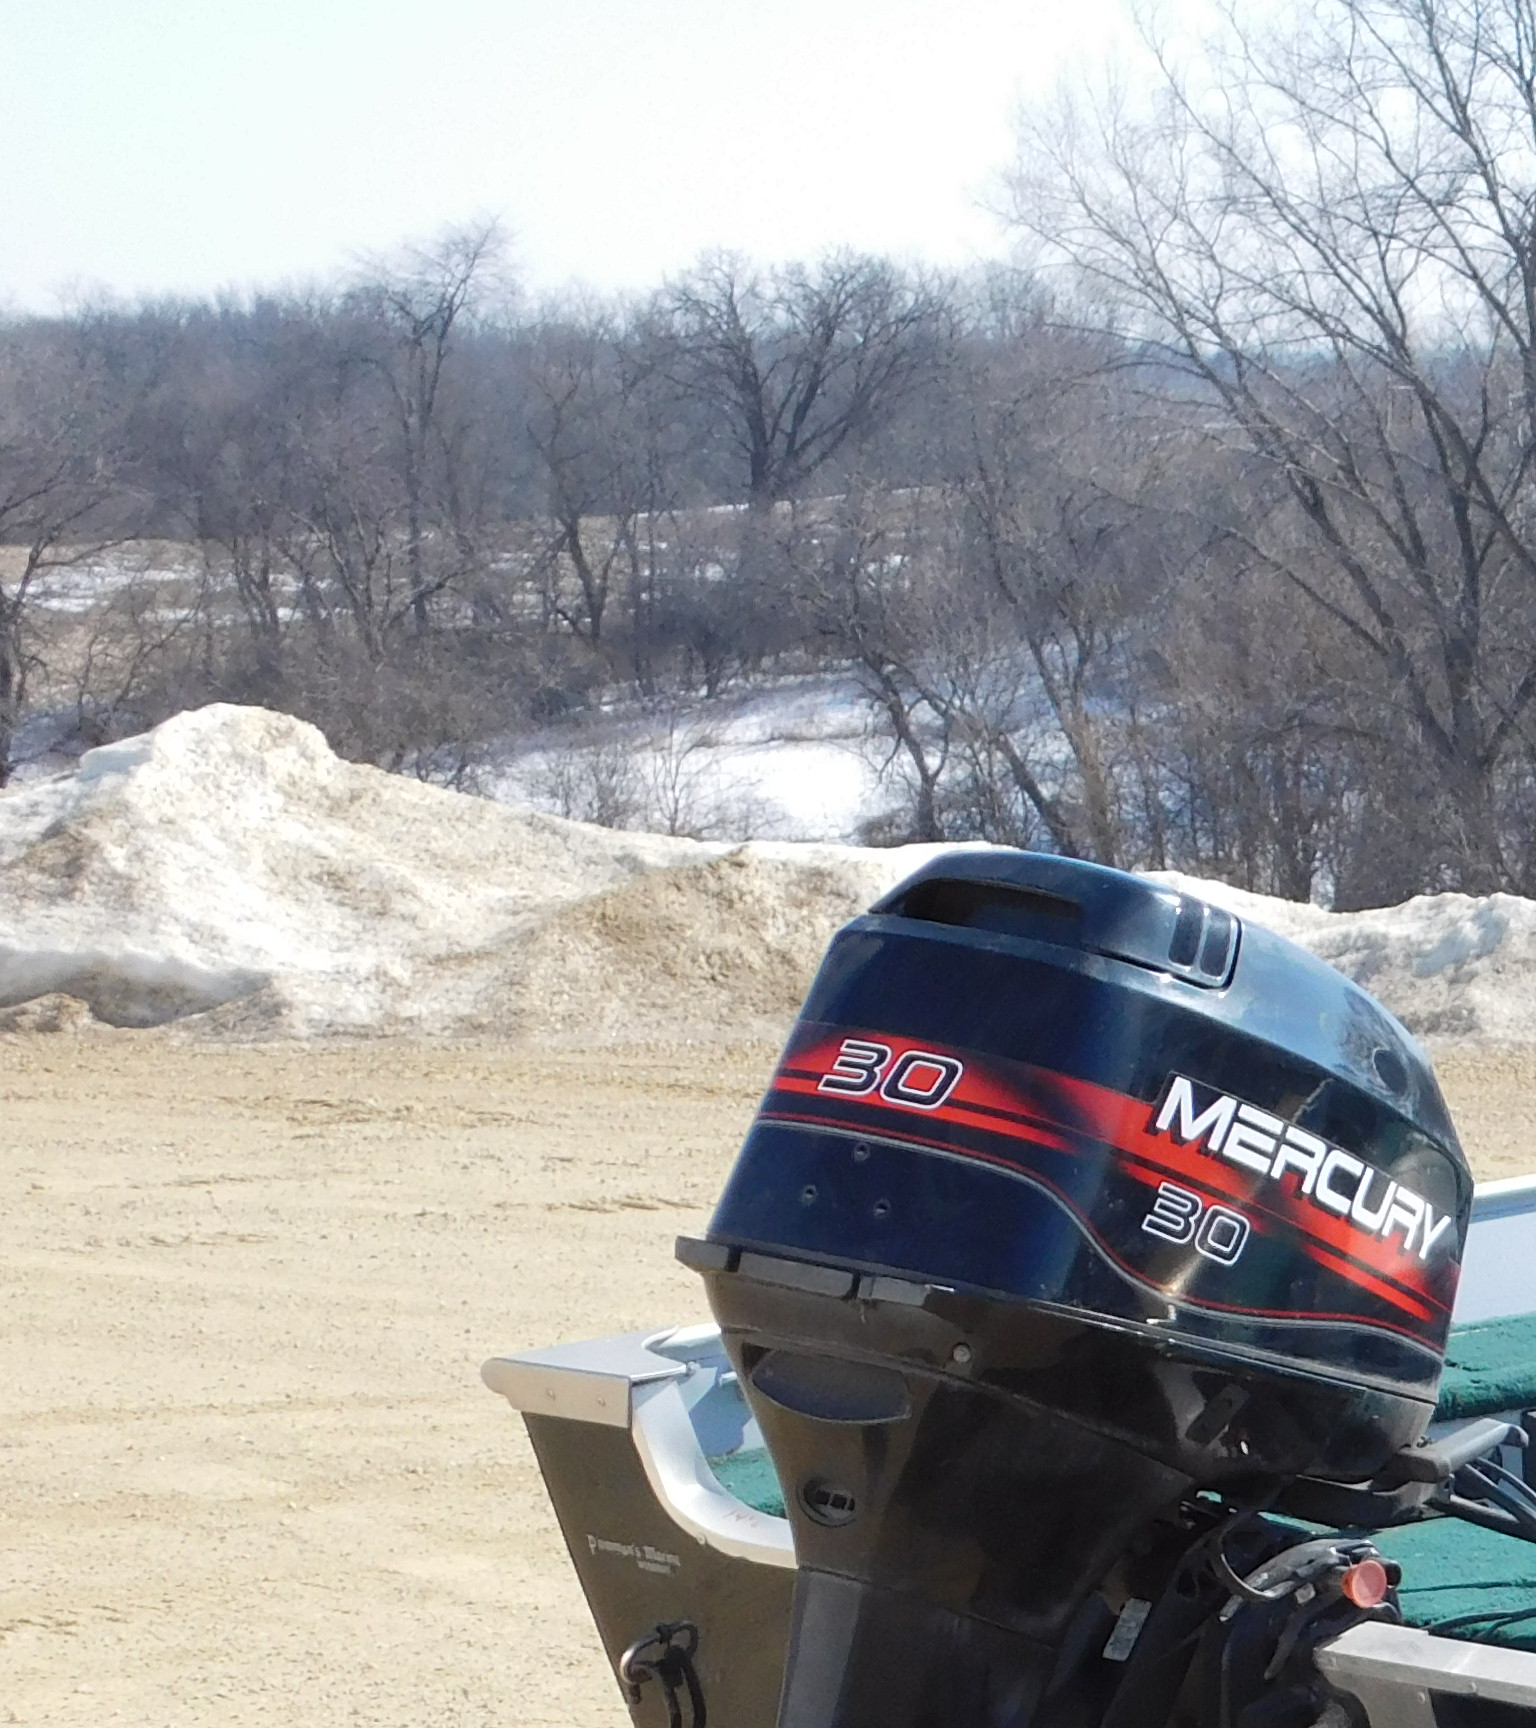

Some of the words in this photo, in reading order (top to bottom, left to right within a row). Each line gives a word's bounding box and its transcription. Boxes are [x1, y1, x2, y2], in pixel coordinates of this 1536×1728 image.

[817, 1038, 963, 1110] 30
[1156, 1076, 1451, 1259] MERCURY
[1141, 1181, 1250, 1266] 30
